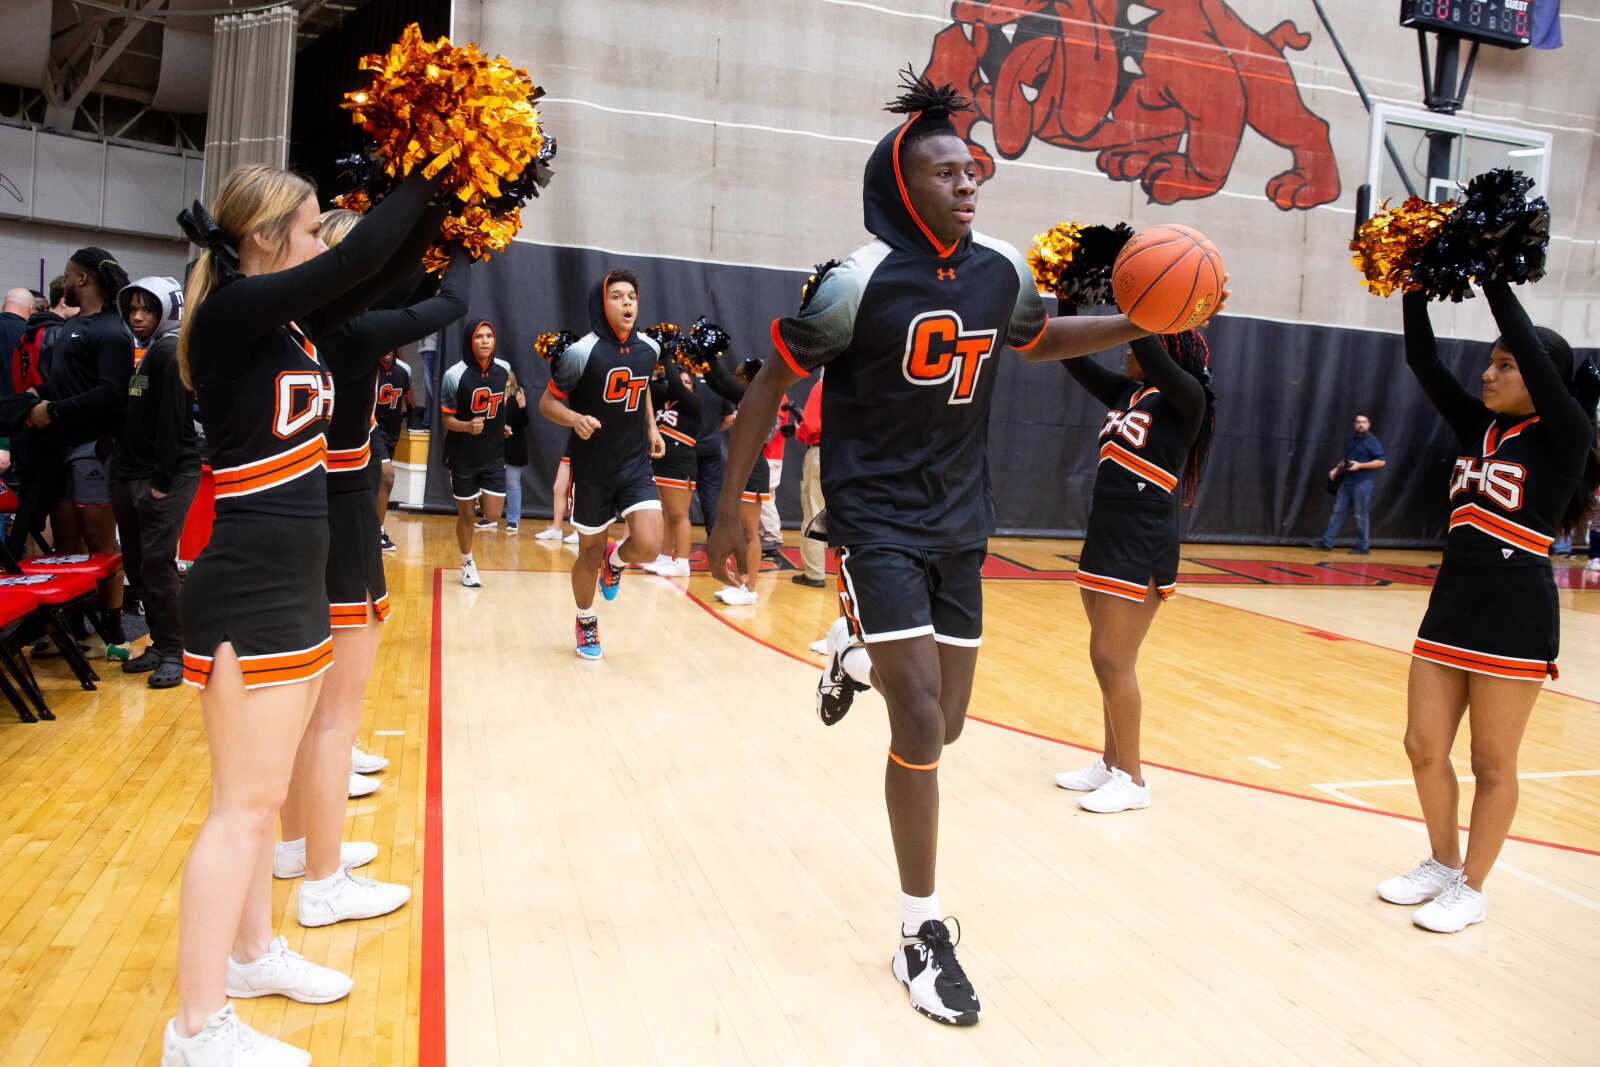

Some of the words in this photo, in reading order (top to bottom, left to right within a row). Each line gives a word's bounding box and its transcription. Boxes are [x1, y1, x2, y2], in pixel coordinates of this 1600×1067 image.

[902, 310, 998, 405] CT
[378, 383, 403, 409] CT
[471, 387, 504, 419] CT
[603, 366, 649, 412] CT
